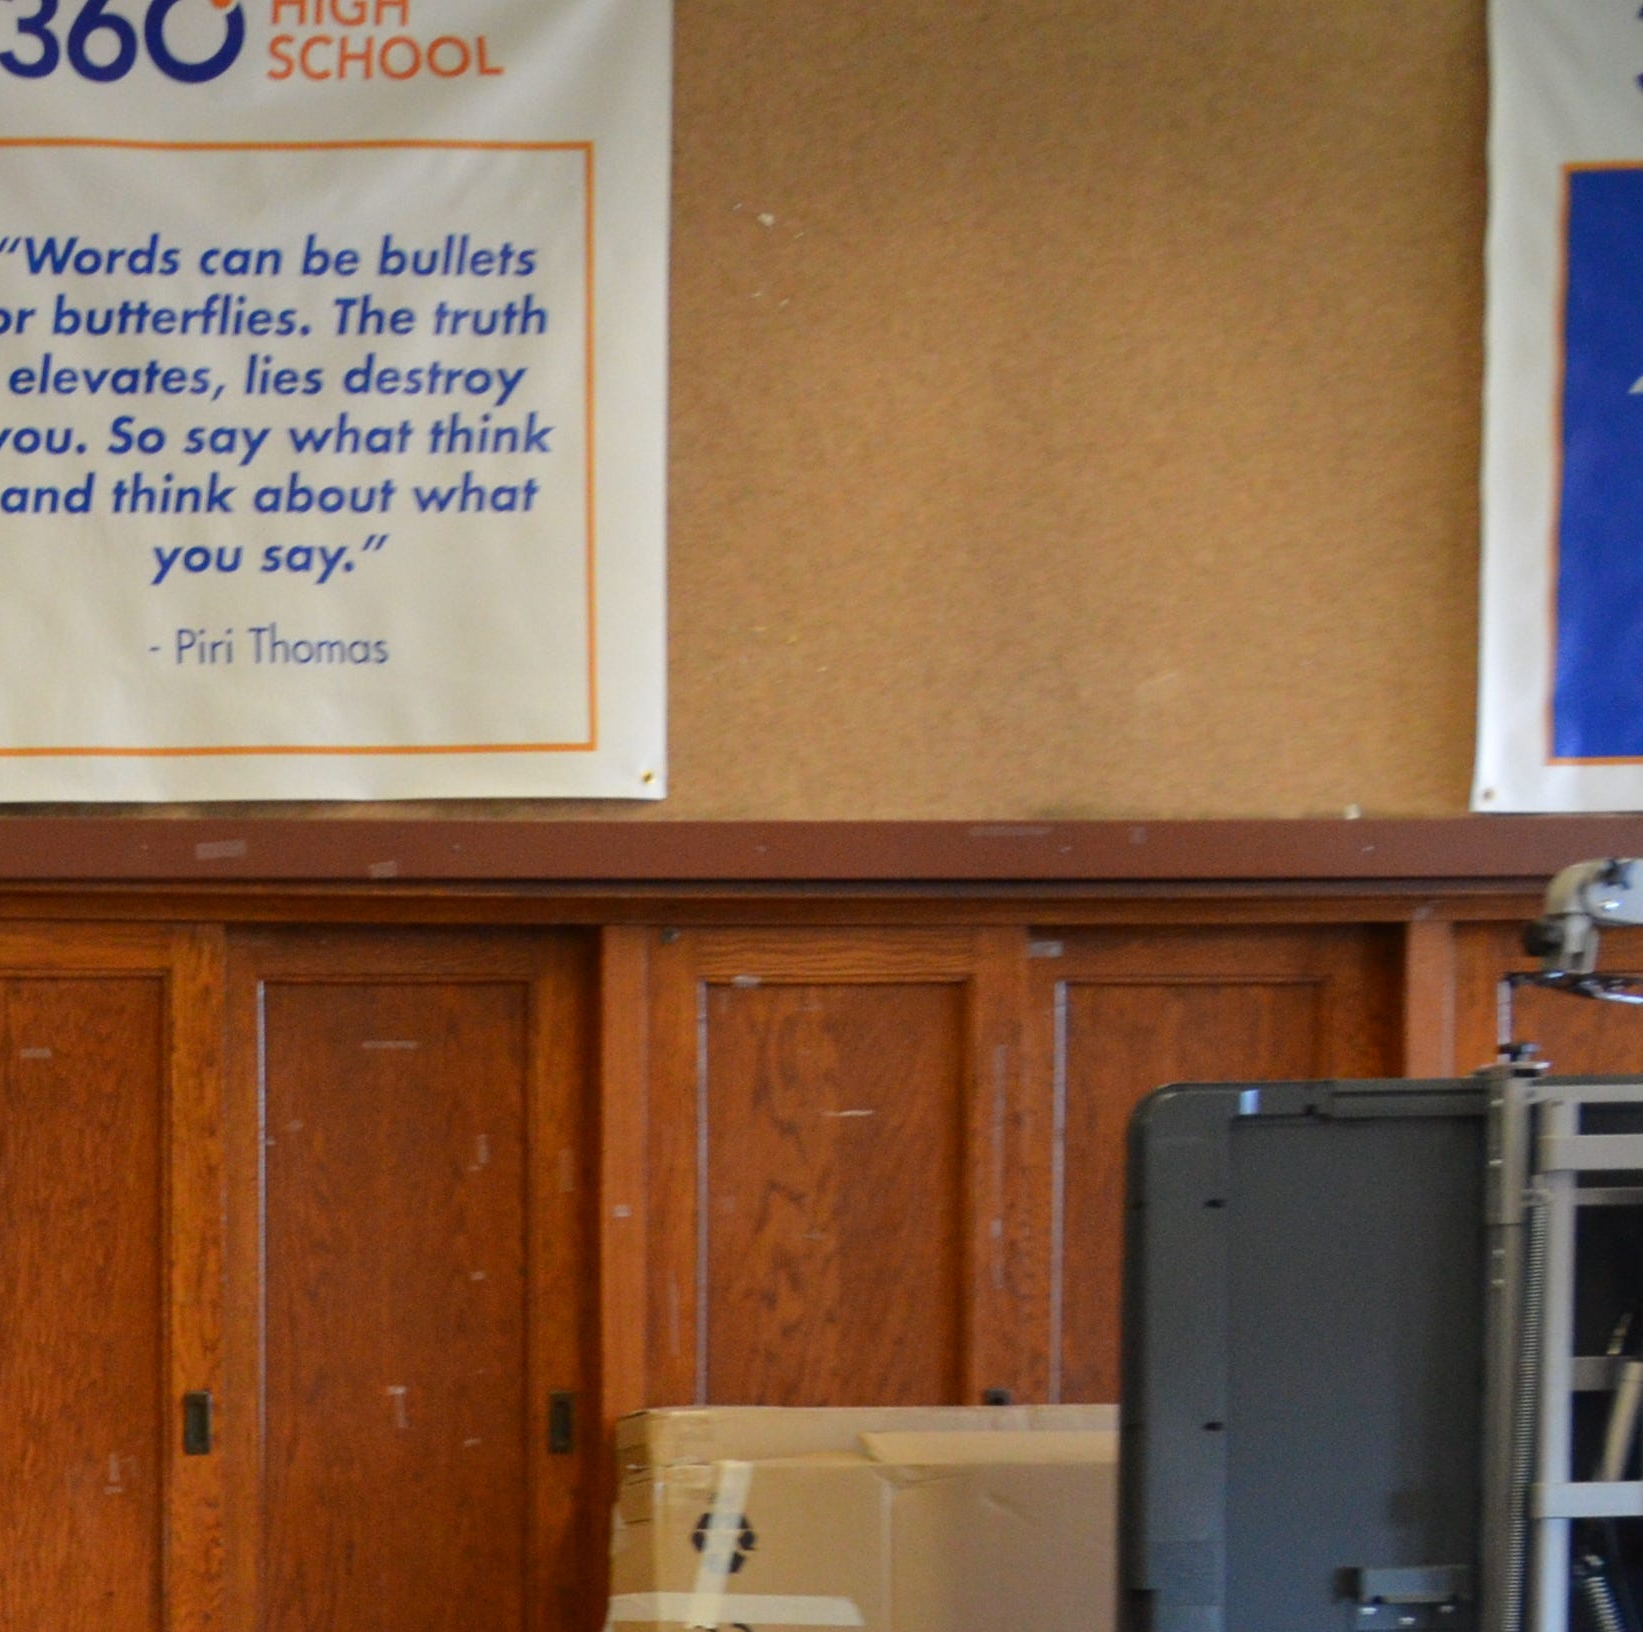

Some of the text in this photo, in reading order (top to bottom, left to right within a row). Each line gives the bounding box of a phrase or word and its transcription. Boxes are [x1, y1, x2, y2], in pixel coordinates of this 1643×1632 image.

[272, 0, 411, 28] HIGH
[267, 34, 506, 82] SCHOOL
[199, 246, 284, 278] can
[301, 232, 362, 278] be
[378, 232, 538, 278] bullets
[51, 292, 314, 338] butterflies.
[333, 292, 418, 338] The
[434, 292, 550, 338] truth
[7, 352, 529, 408] elevates, lies destroy
[107, 414, 168, 456] So
[183, 427, 273, 467] say
[288, 411, 415, 456] what
[428, 411, 553, 456] think
[0, 471, 540, 516] and think about what
[151, 534, 391, 586] you say.”
[175, 627, 233, 666] Piri
[248, 623, 390, 667] Thomas
